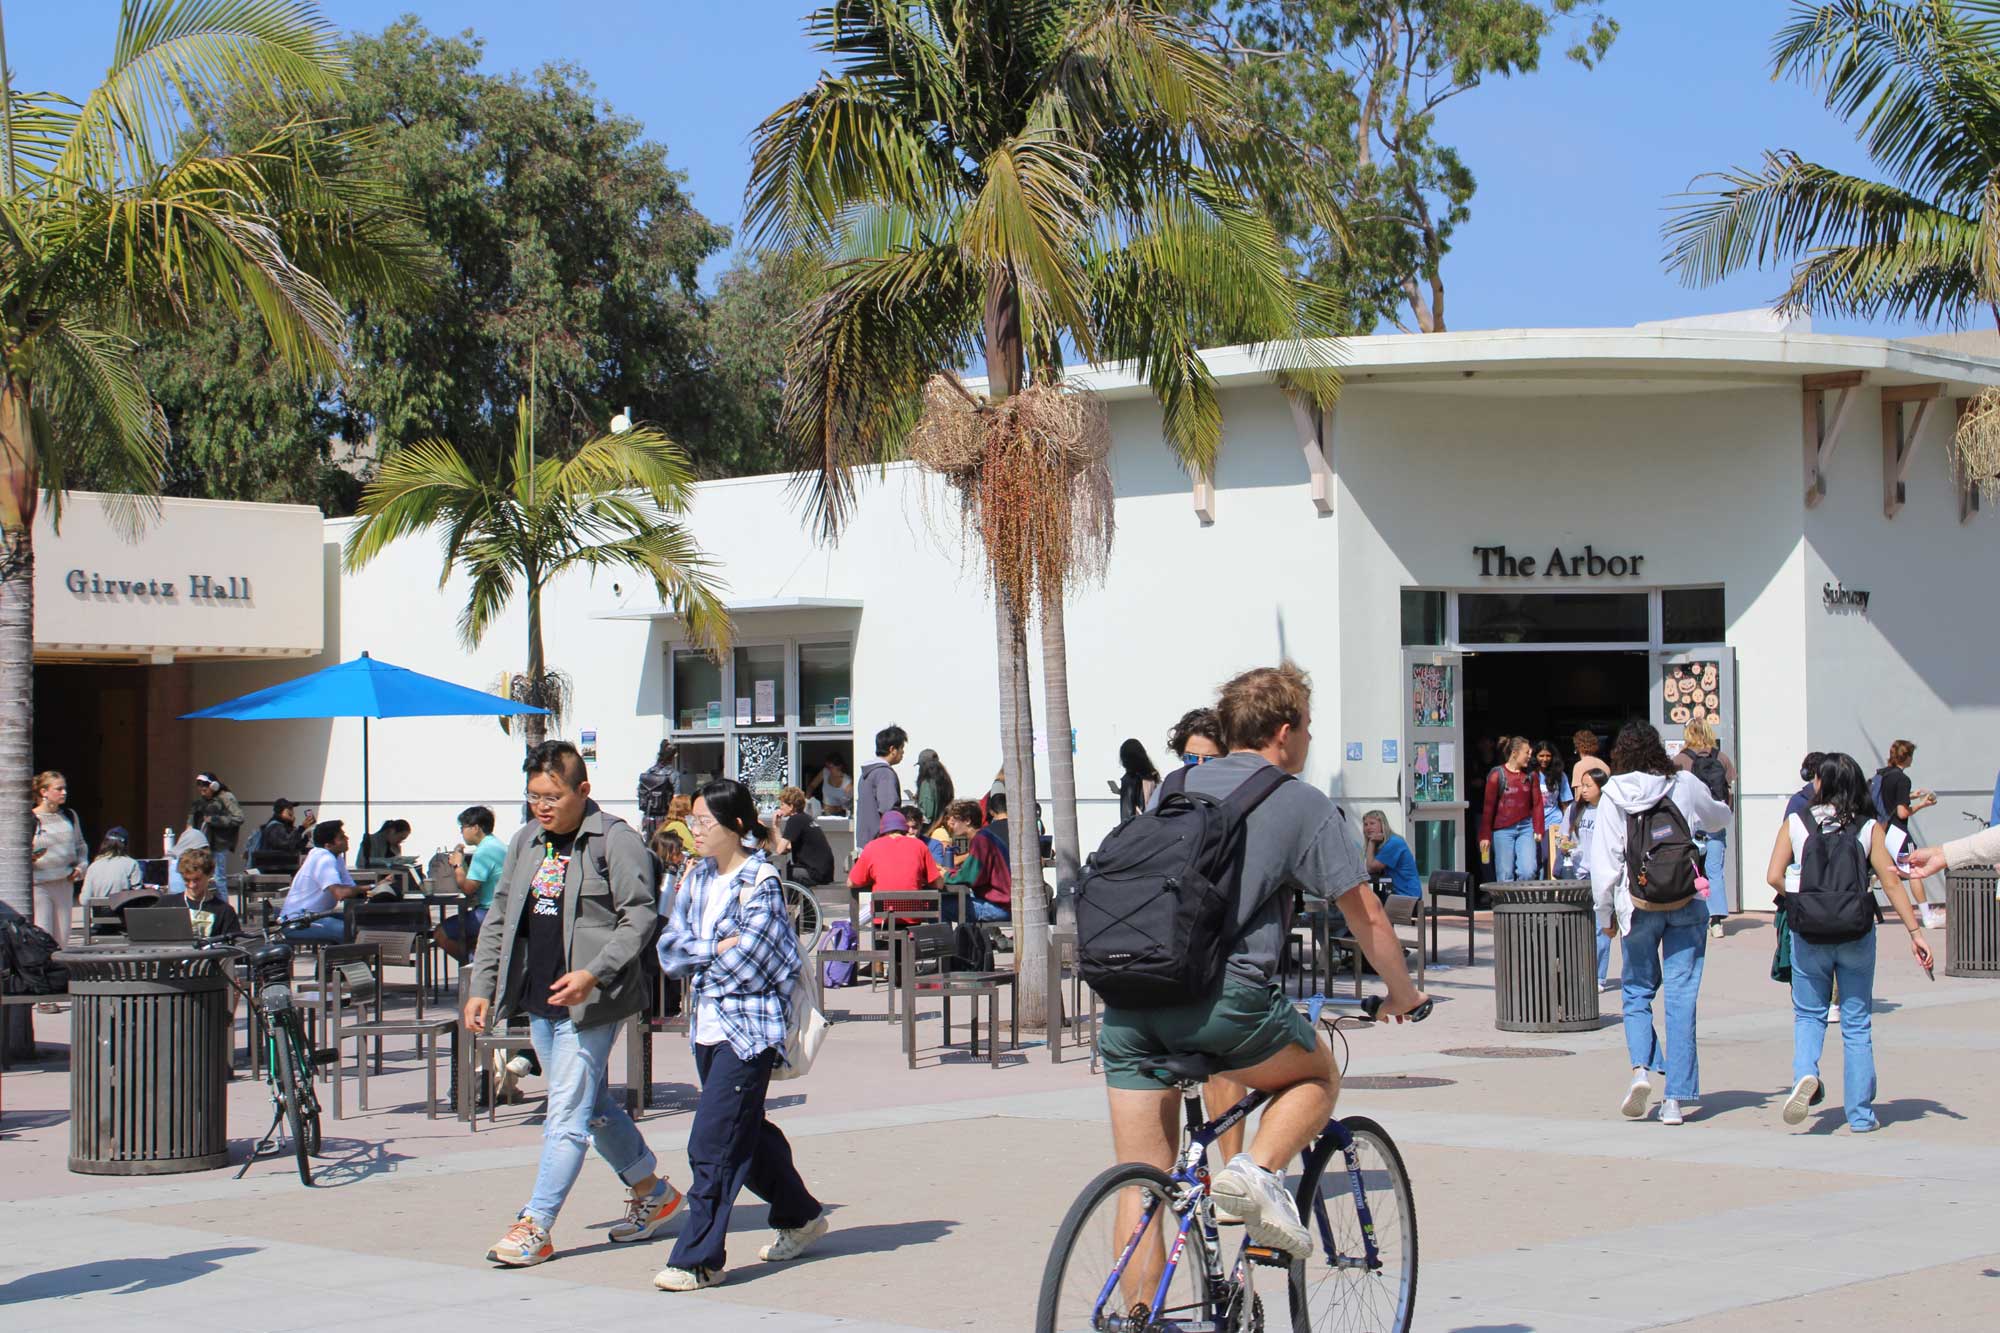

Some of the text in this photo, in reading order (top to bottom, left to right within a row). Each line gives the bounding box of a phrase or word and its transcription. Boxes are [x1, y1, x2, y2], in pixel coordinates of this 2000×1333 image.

[1472, 544, 1644, 577] The Arbor
[65, 569, 251, 600] Girvetz Hall
[1822, 581, 1870, 612] Subway
